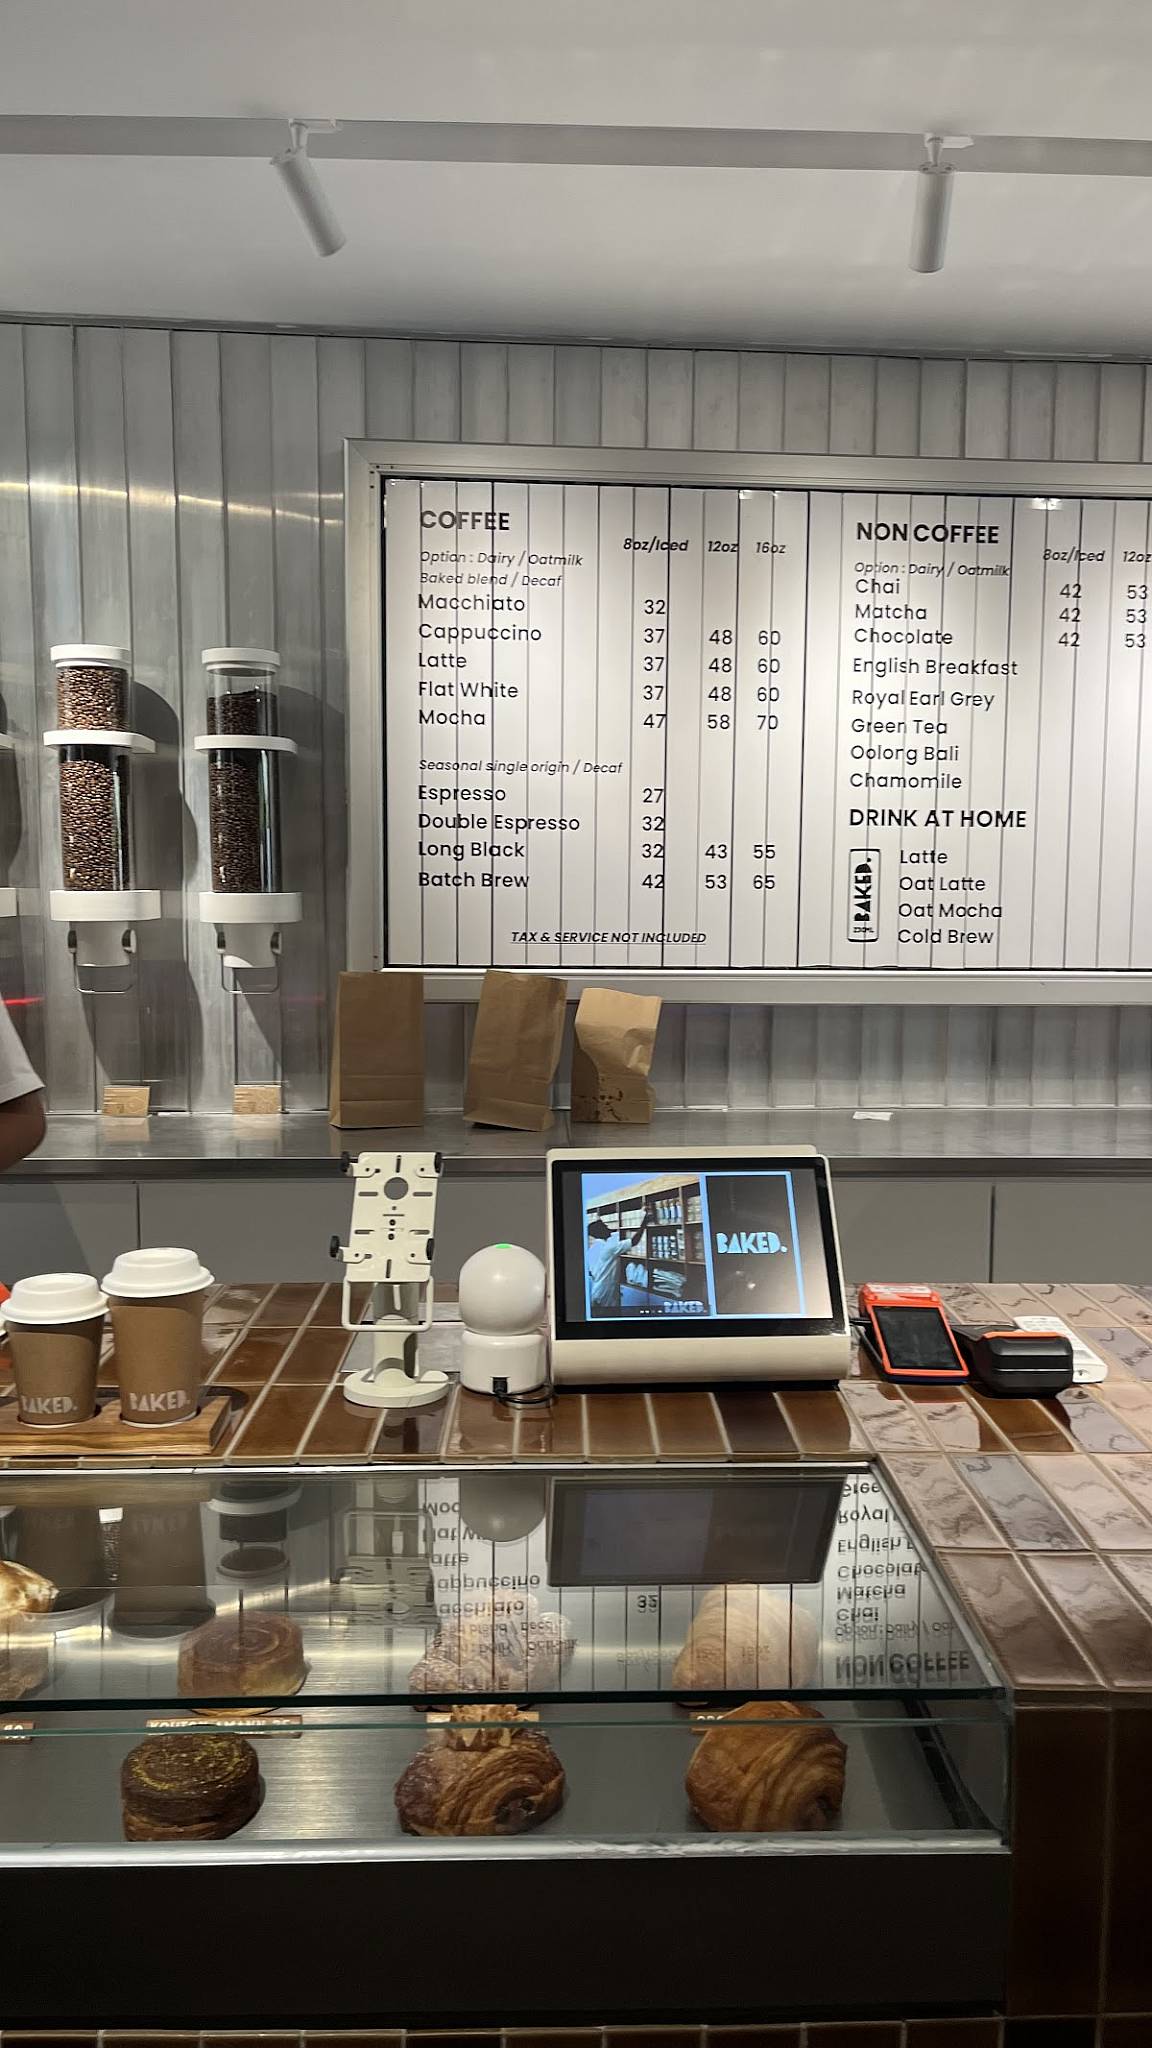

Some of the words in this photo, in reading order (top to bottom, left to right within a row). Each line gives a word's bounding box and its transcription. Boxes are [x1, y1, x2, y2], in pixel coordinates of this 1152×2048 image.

[420, 511, 511, 531] COFFEE
[857, 522, 908, 541] NON
[913, 524, 999, 544] COFFEE
[623, 536, 689, 553] 8oz/Iced
[707, 539, 740, 553] 12oz
[755, 541, 787, 555] 16oz
[1043, 546, 1106, 563] 8oz/Iced
[478, 552, 515, 567] Dairy
[528, 553, 583, 566] Oatmilk
[420, 572, 463, 585] Baked
[467, 573, 507, 586] blend
[522, 574, 562, 587] Decaf
[909, 563, 944, 578] Dairy
[958, 564, 1010, 576] Oatmilk
[855, 578, 900, 594] Chai
[1059, 583, 1082, 598] 42
[1127, 584, 1148, 600] 53
[418, 593, 526, 612] Macchiato
[644, 599, 667, 615] 32
[855, 603, 927, 620] Matcha
[1059, 607, 1081, 622] 42
[1126, 608, 1147, 624] 53
[418, 623, 542, 643] Cappuccino
[643, 628, 666, 644] 37
[708, 630, 733, 645] 48
[758, 630, 781, 646] 60
[854, 628, 953, 645] Chocolate
[1058, 632, 1080, 647] 42
[1124, 633, 1146, 648] 53
[418, 652, 467, 668] Latte
[643, 656, 666, 672] 37
[708, 657, 733, 673] 48
[757, 658, 780, 673] 60
[853, 658, 919, 678] English
[925, 659, 1018, 676] Breakfast
[418, 681, 454, 697] Flat
[460, 682, 518, 698] White
[643, 685, 665, 701] 37
[708, 686, 733, 702] 48
[757, 686, 780, 702] 60
[852, 690, 904, 710] Royal
[909, 690, 944, 707] Earl
[950, 692, 995, 711] Grey
[418, 709, 486, 726] Mocha
[643, 713, 667, 729] 47
[707, 715, 731, 730] 58
[757, 715, 779, 730] 70
[851, 718, 906, 733] Green
[912, 719, 948, 734] Tea
[851, 745, 917, 765] Oolong
[924, 745, 959, 761] Bali
[419, 759, 482, 772] Seasonal
[485, 760, 528, 775] single
[530, 761, 569, 775] origin
[583, 761, 623, 774] Decaf
[850, 773, 962, 789] Chamomile
[418, 785, 506, 806] Espresso
[642, 788, 664, 804] 27
[418, 813, 487, 831] Double
[494, 815, 580, 835] Espresso
[642, 816, 665, 831] 32
[849, 808, 917, 826] DRINK
[924, 809, 954, 827] AT
[960, 810, 1026, 828] HOME
[418, 842, 465, 862] Long
[471, 842, 525, 859] Black
[642, 844, 665, 859] 32
[705, 844, 728, 860] 43
[753, 844, 776, 860] 55
[900, 850, 948, 864] Latte
[418, 871, 475, 888] Batch
[481, 873, 529, 888] Brew
[642, 874, 665, 889] 42
[705, 874, 727, 890] 53
[753, 875, 776, 890] 65
[899, 876, 934, 891] Oat
[940, 876, 986, 891] Latte
[898, 902, 933, 918] Oat
[939, 903, 1003, 918] Mocha
[511, 931, 537, 943] TAX
[540, 931, 550, 944] &
[554, 932, 608, 944] SERVICE
[611, 932, 638, 944] NOT
[641, 932, 706, 944] INCLUDED
[898, 929, 941, 944] Cold
[948, 929, 994, 944] Brew
